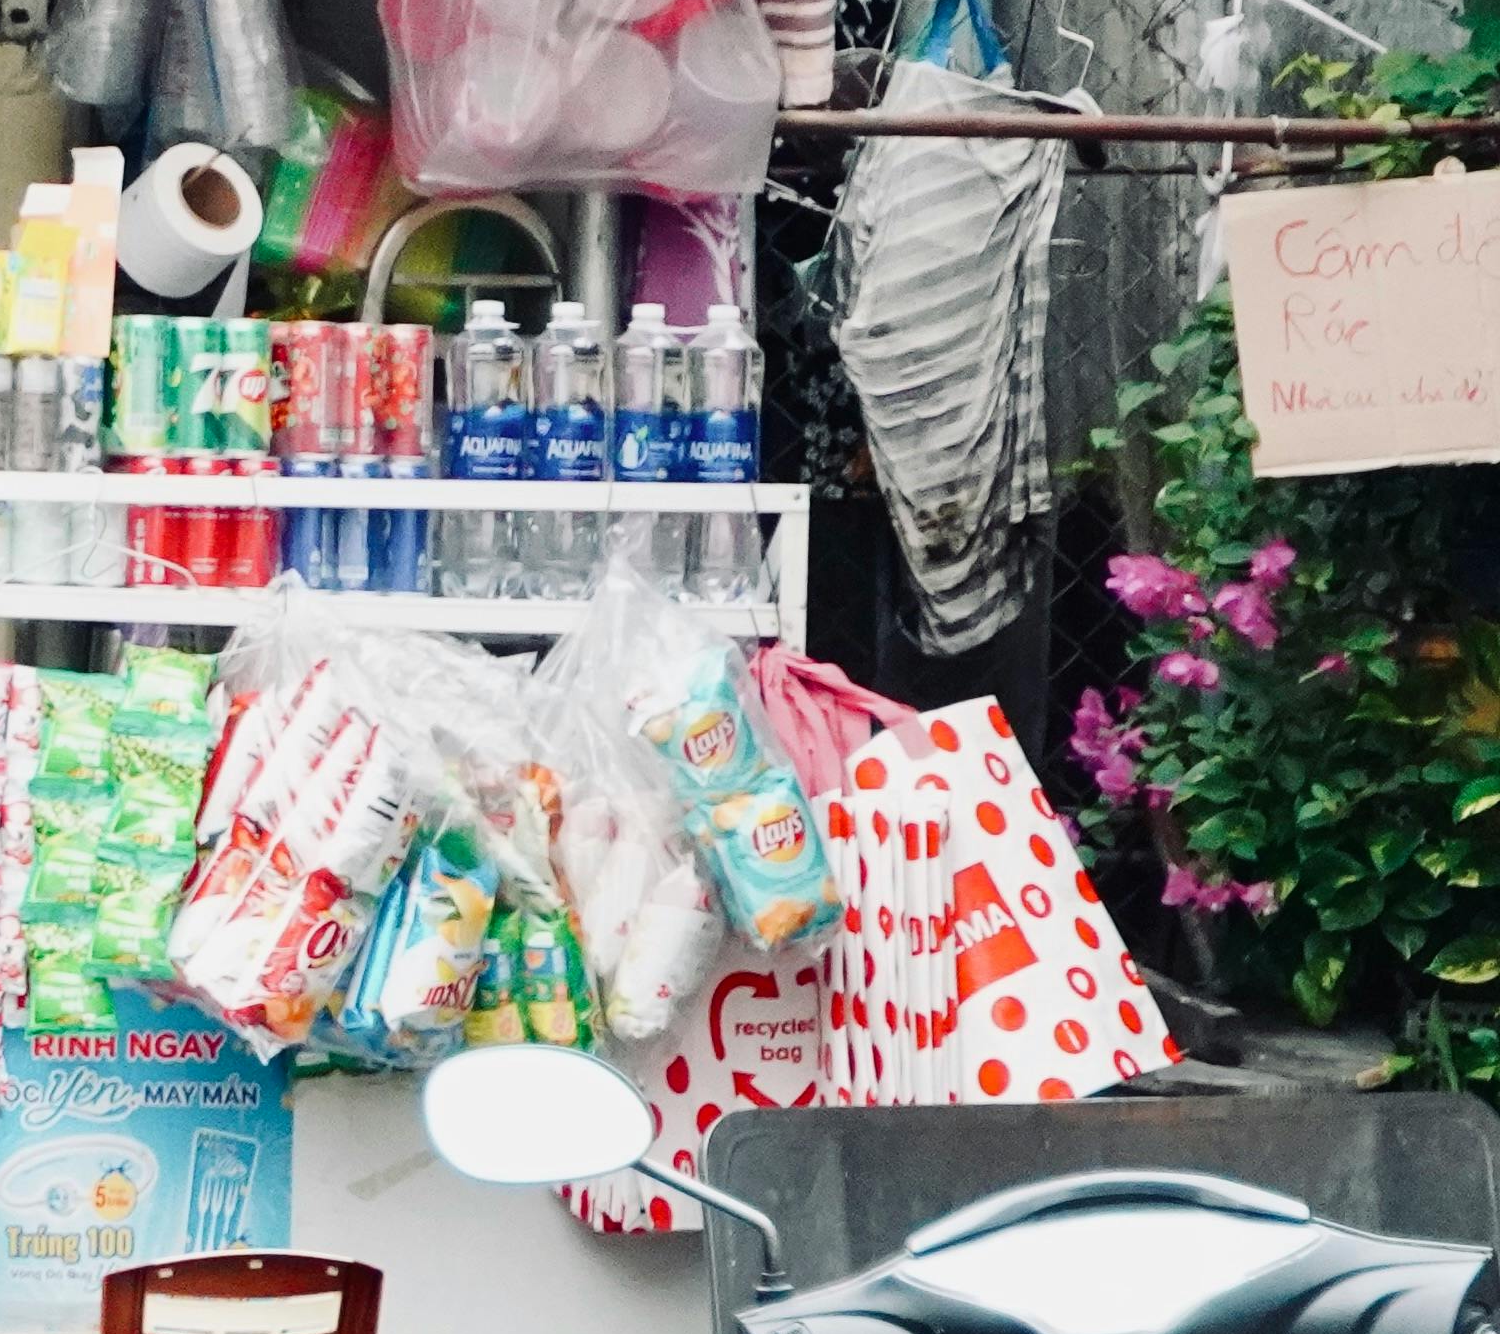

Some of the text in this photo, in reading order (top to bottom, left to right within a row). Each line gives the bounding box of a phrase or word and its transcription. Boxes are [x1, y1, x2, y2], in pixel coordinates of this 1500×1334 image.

[684, 711, 736, 765] Lay's
[752, 809, 805, 857] Lay's
[128, 1032, 225, 1060] NGAY
[760, 1043, 804, 1065] bag
[143, 1084, 198, 1105] MAY
[6, 1225, 135, 1264] Trúng 100
